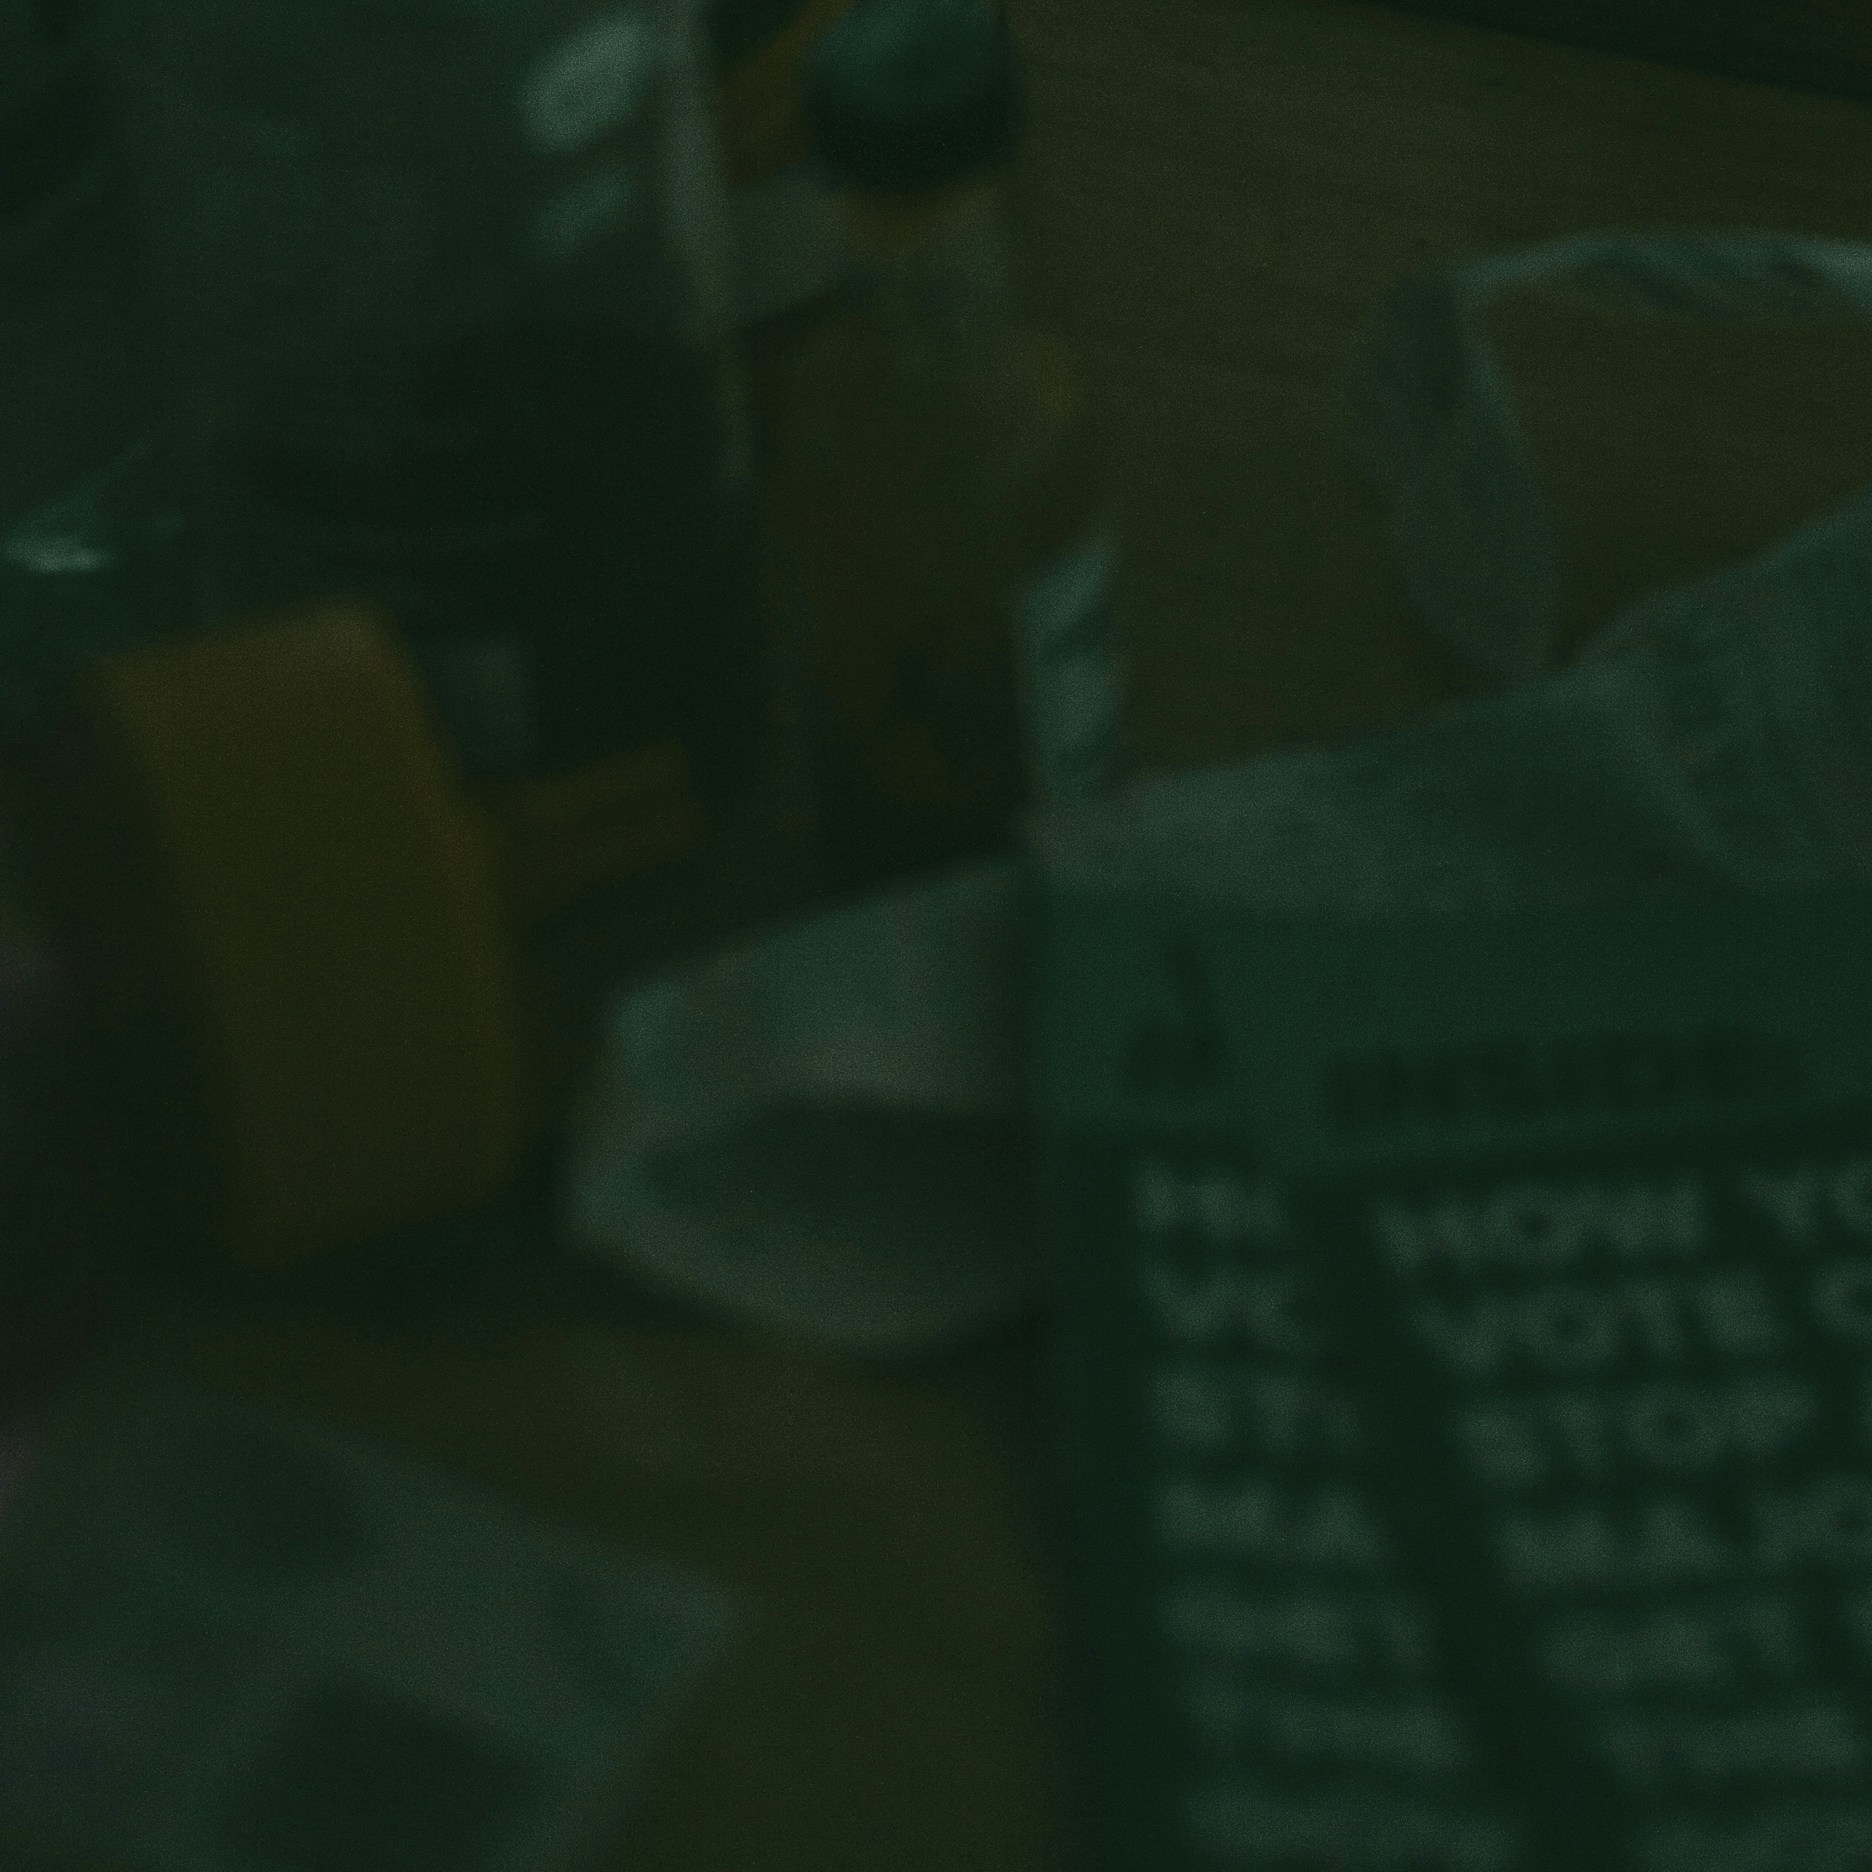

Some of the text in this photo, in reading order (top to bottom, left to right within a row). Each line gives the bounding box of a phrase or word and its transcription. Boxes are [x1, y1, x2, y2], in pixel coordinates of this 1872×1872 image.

[1368, 1174, 1706, 1278] HOW
[1411, 1278, 1780, 1379] VOTE
[1453, 1374, 1818, 1489] STOP
